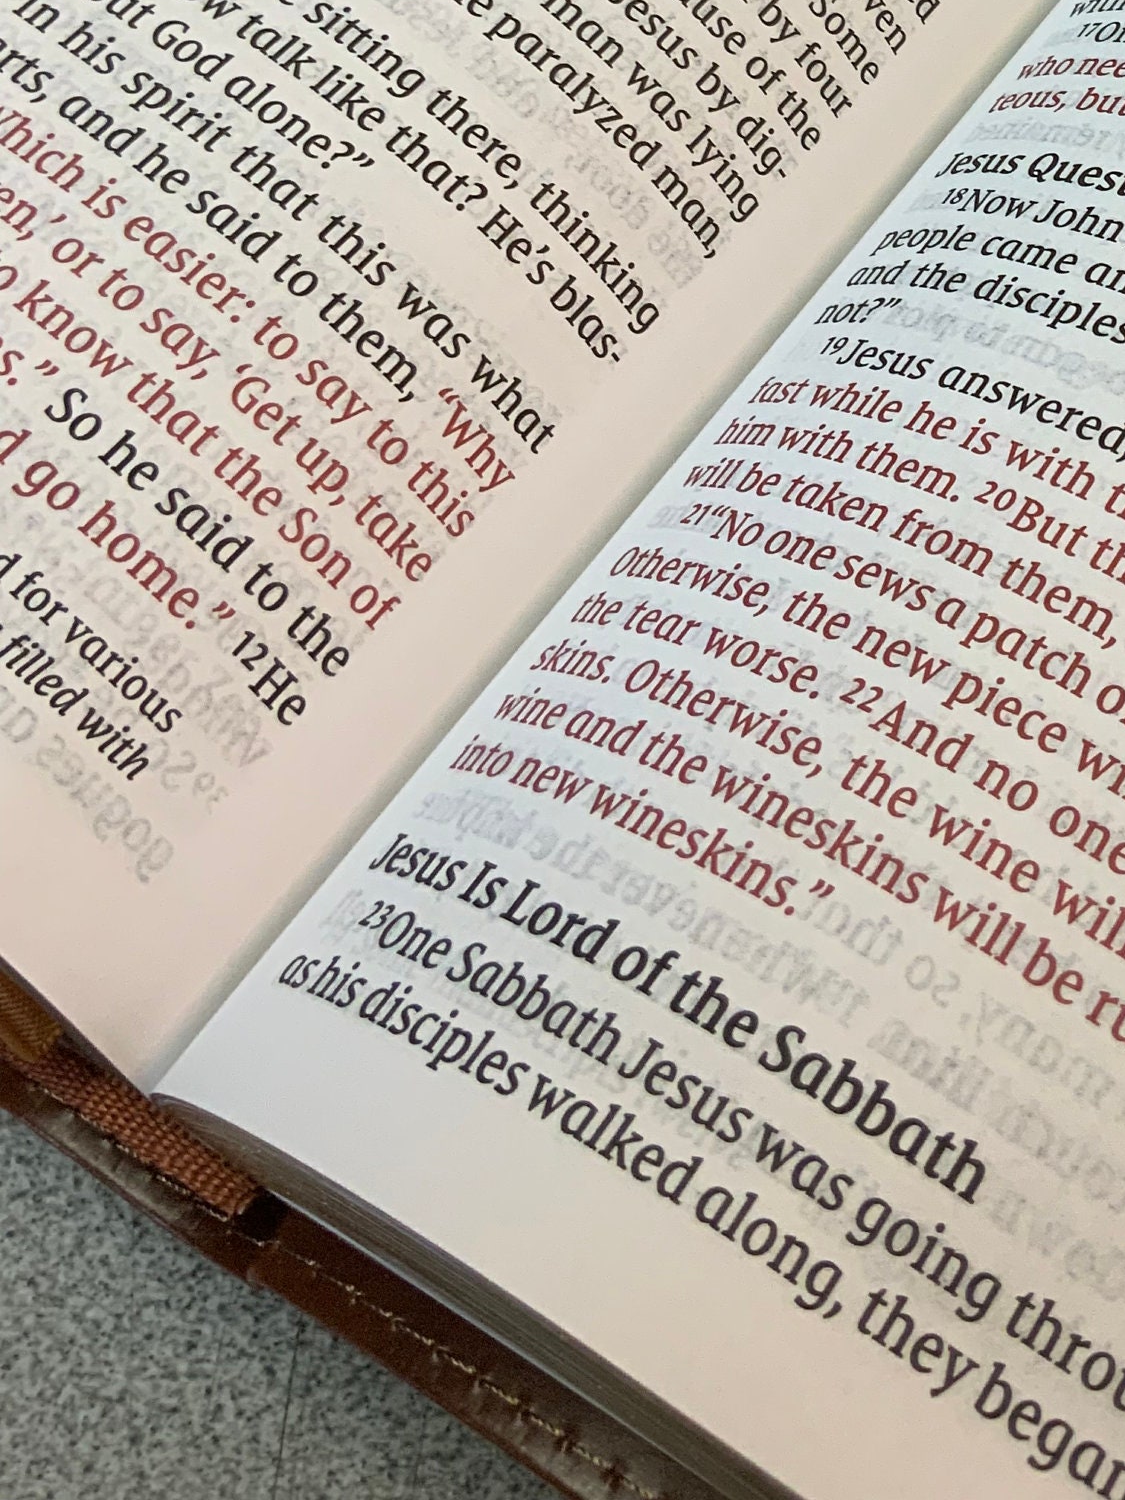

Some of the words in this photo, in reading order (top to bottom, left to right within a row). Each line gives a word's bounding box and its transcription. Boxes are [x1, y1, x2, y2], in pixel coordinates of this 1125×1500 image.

[934, 151, 1026, 179] Jesus
[987, 90, 1068, 114] teous,
[869, 224, 977, 257] people
[979, 235, 1079, 275] came
[12, 278, 135, 379] know
[126, 371, 220, 457] that
[213, 446, 284, 517] the
[277, 507, 352, 591] Son
[349, 584, 402, 631] of
[747, 375, 810, 405] fast
[809, 382, 904, 424] while
[903, 400, 957, 441] he
[958, 417, 1001, 456] is
[1005, 439, 1096, 501] with
[43, 387, 103, 442] So
[97, 428, 160, 492] he
[153, 487, 255, 574] said
[243, 562, 290, 613] to
[286, 605, 350, 678] the
[0, 633, 90, 718] filled
[76, 706, 150, 782] with
[8, 570, 69, 627] for
[64, 615, 183, 734] various
[448, 734, 515, 778] into
[508, 756, 595, 805] new
[588, 783, 836, 917] wineskins.”
[368, 832, 469, 892] Jesus
[456, 860, 509, 910] Is
[498, 878, 621, 966] Lord
[610, 945, 680, 997] of
[668, 970, 760, 1049] the
[757, 1024, 987, 1205] Sabbath
[279, 954, 321, 989] as
[306, 954, 368, 1009] his
[358, 981, 531, 1097] disciples
[527, 1072, 704, 1207] walked
[694, 1185, 843, 1320] along,
[856, 1288, 981, 1399] they
[444, 942, 622, 1067] Sabbath
[616, 1037, 755, 1144] Jesus
[754, 1121, 856, 1212] was
[844, 1196, 1003, 1324] going
